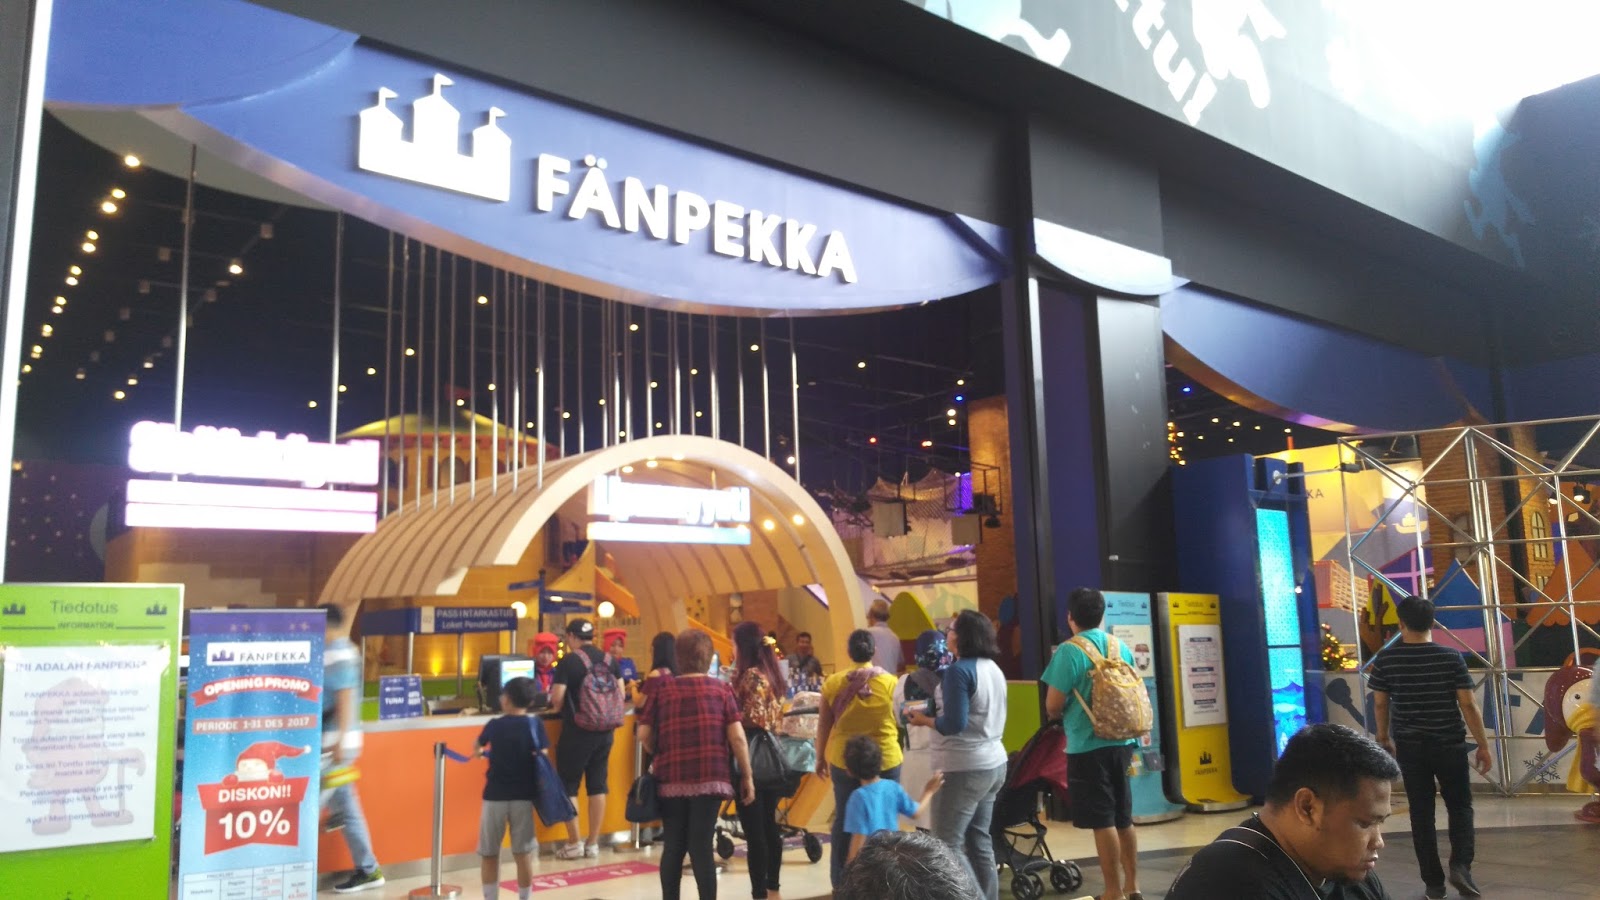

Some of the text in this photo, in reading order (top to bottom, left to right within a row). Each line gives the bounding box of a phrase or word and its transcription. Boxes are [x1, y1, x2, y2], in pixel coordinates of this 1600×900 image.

[537, 152, 858, 284] FÄNPEKKA
[50, 600, 119, 615] Tiedotus
[58, 622, 115, 630] INFORMATION
[442, 620, 463, 630] Loket
[34, 662, 84, 672] ADALAH
[204, 677, 311, 696] OPENING PROMO
[196, 716, 310, 731] PERIODE 1-31 DES 2017
[218, 784, 292, 803] DISKON!!
[218, 806, 291, 840] 10%
